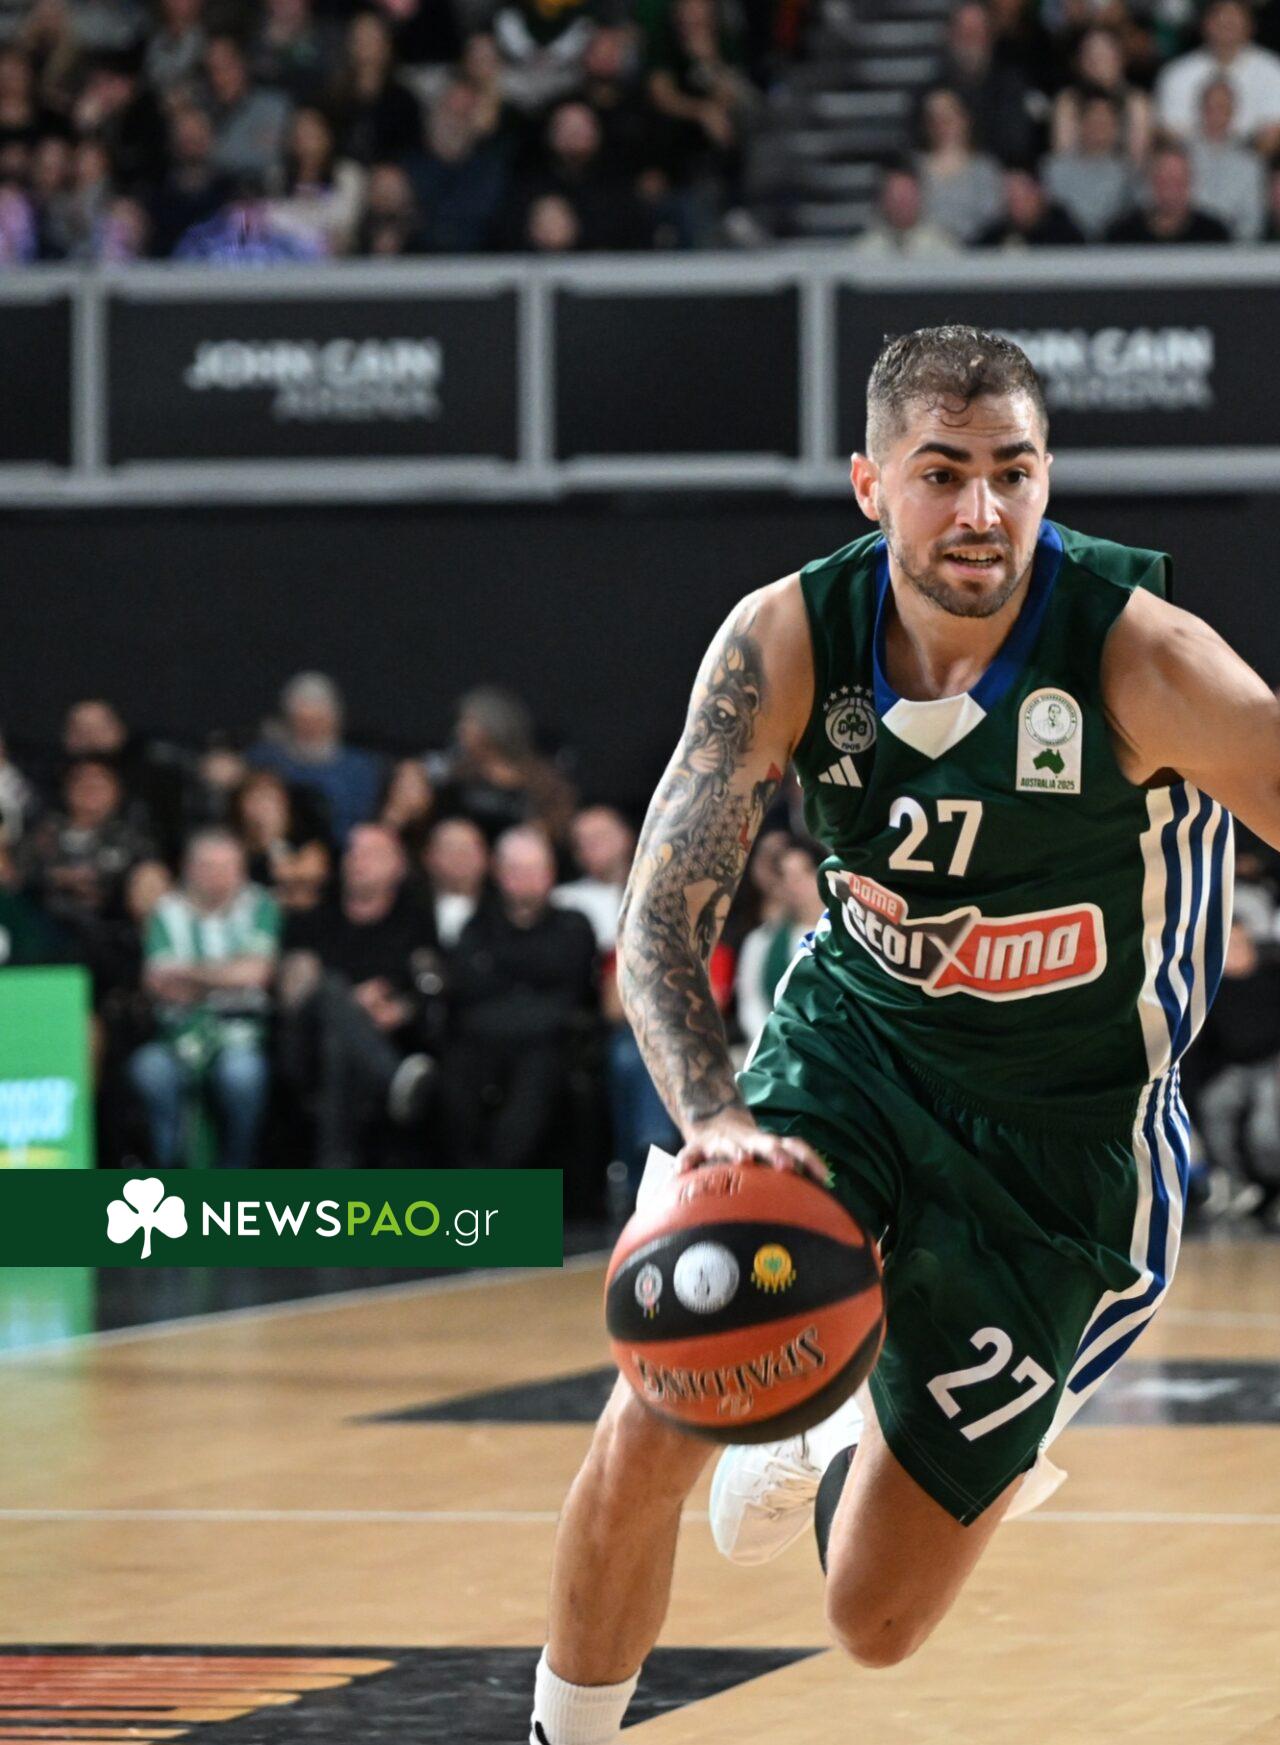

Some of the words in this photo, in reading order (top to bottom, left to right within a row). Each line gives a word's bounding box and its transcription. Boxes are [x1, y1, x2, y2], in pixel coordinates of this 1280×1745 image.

[185, 340, 315, 390] JOHN
[321, 338, 443, 385] CAIN
[1092, 327, 1213, 374] CAIN
[1020, 777, 1056, 789] AUSTRALIA
[1057, 779, 1075, 790] 2025
[889, 796, 983, 877] 27
[632, 1324, 826, 1403] SPALDING
[925, 1326, 1055, 1442] 27
